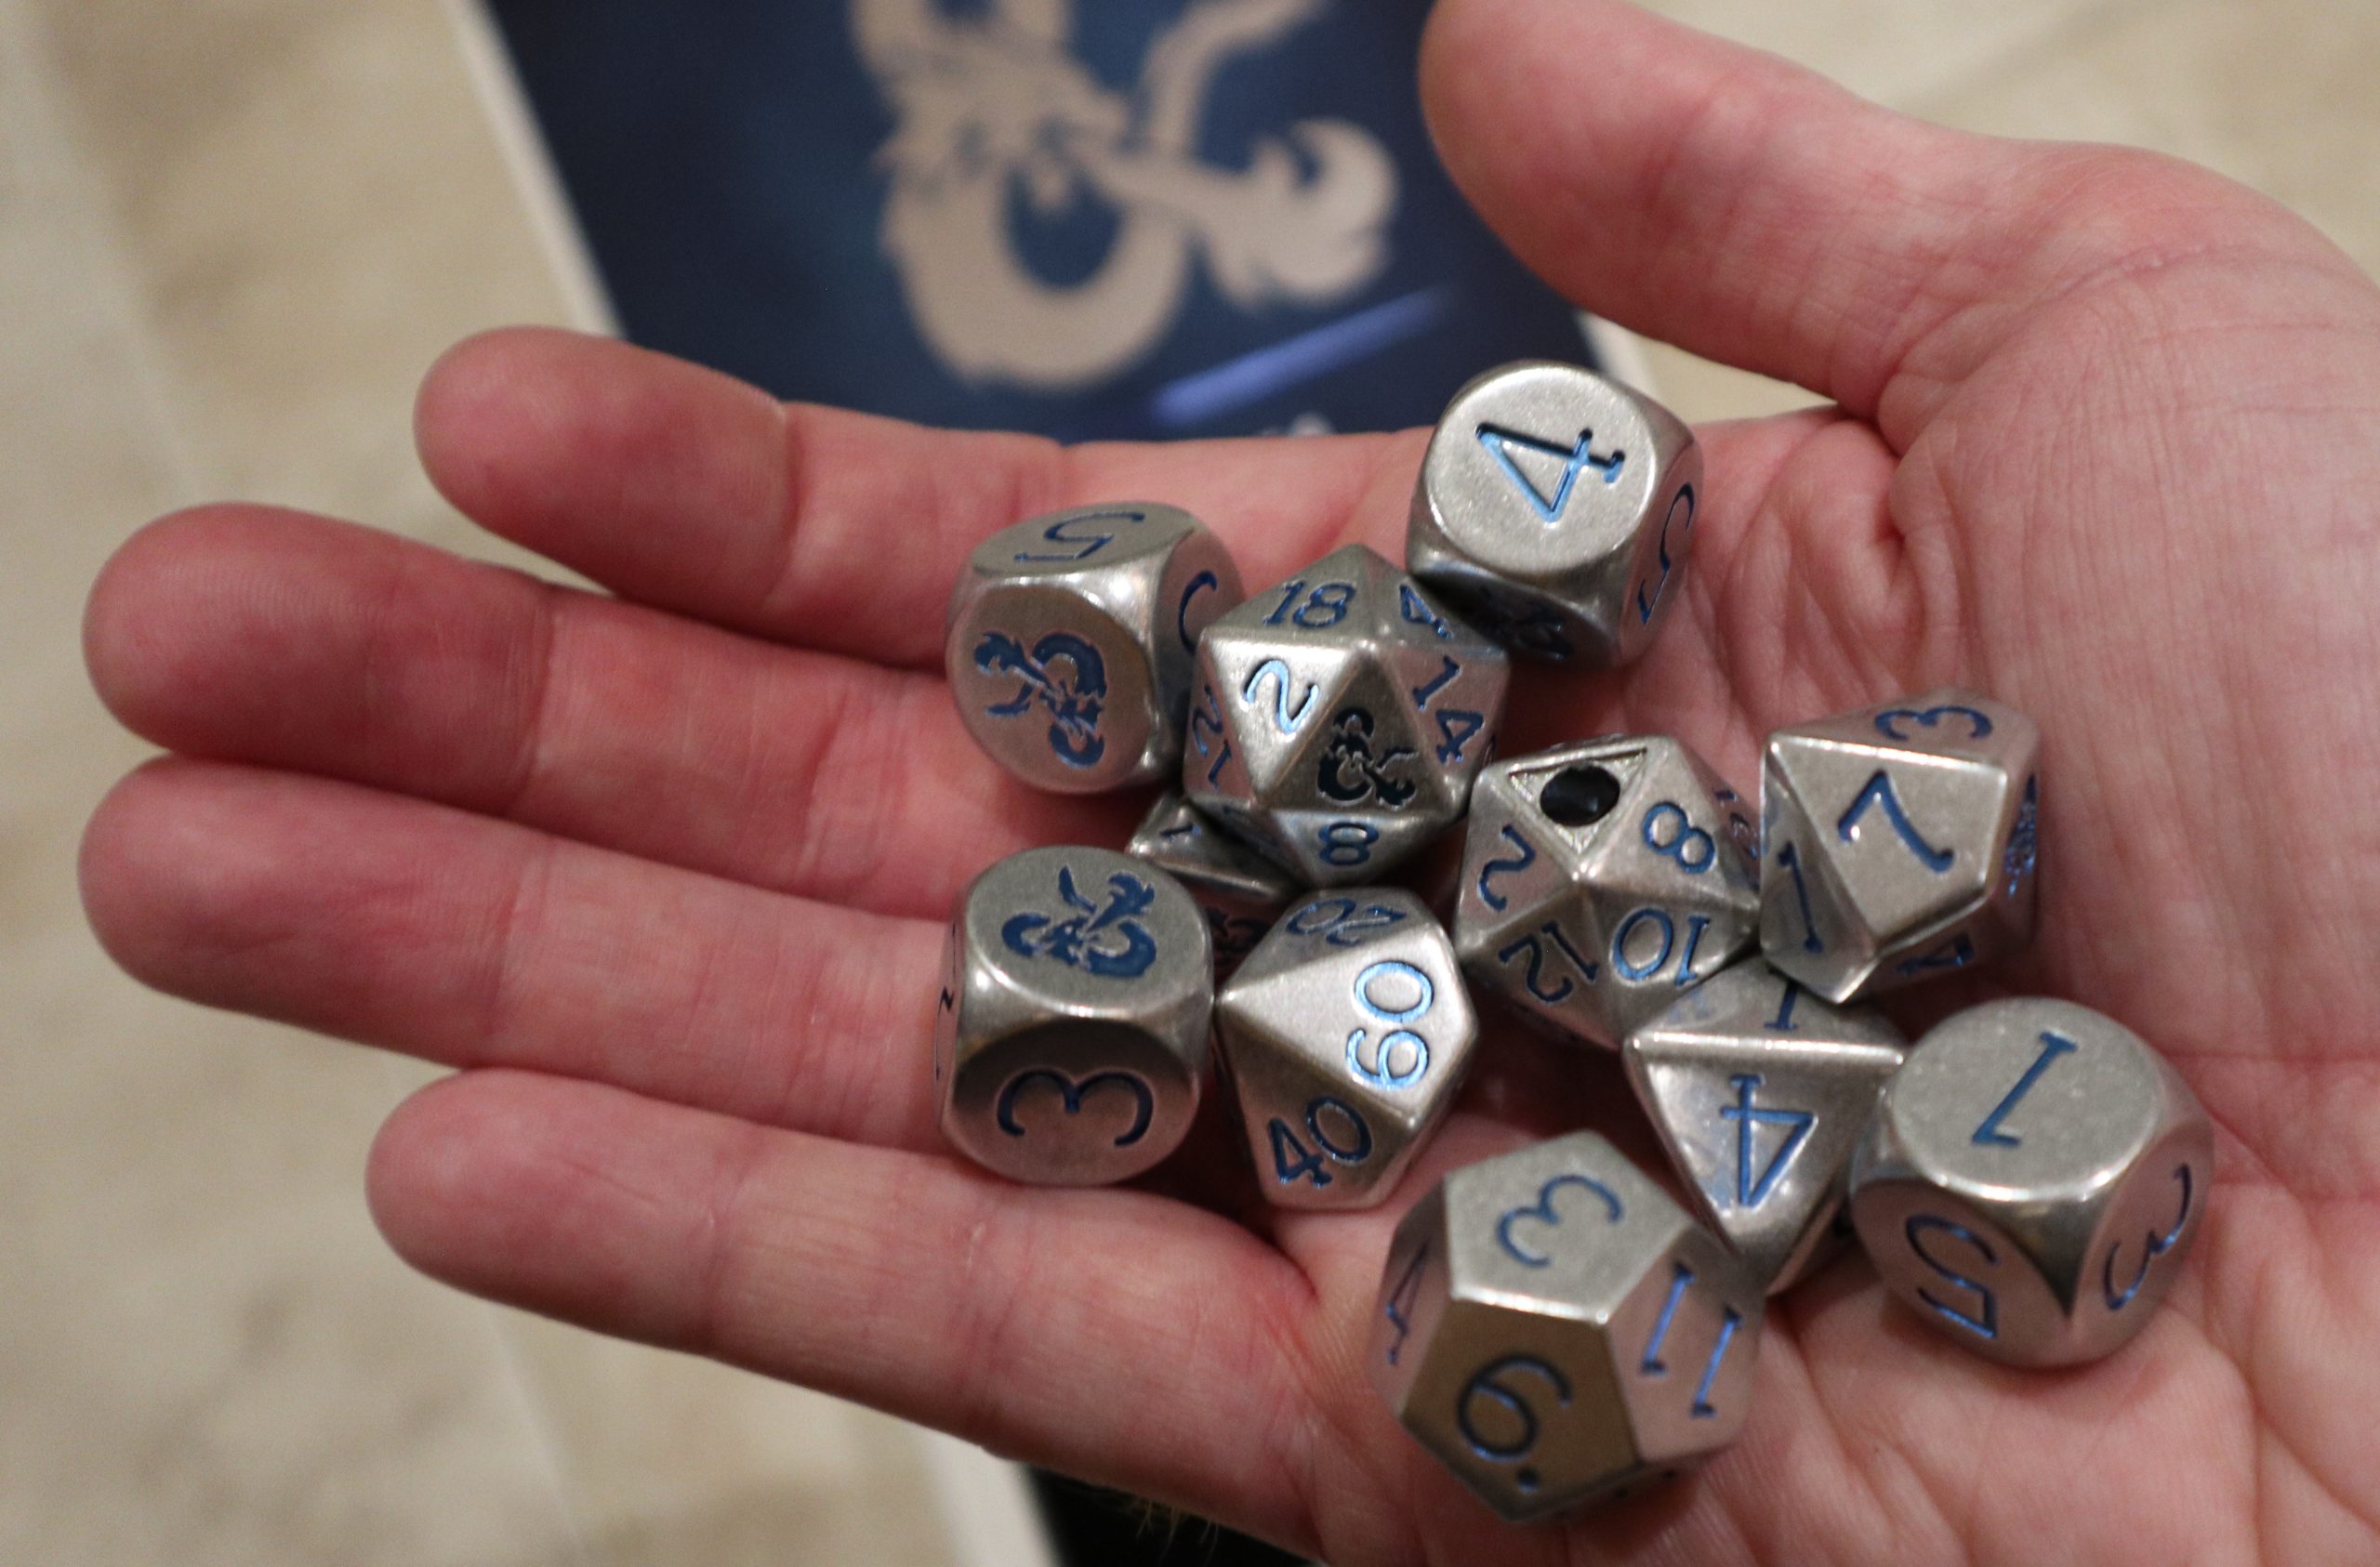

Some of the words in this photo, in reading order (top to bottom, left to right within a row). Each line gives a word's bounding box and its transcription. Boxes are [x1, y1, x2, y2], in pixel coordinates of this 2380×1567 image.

[1475, 422, 1625, 522] 4
[1013, 512, 1145, 561] 5
[1262, 579, 1356, 630] 18
[1398, 584, 1454, 641] 4
[1241, 658, 1320, 736] 2
[1874, 705, 1993, 741] 3
[1316, 822, 1380, 866] 8
[1640, 801, 1718, 876] 8
[1837, 770, 1956, 875] 7
[1778, 841, 1824, 955] 1
[1497, 920, 1601, 1005] 12
[1610, 906, 1712, 987] 10
[1346, 959, 1435, 1091] 60
[997, 1071, 1154, 1148] 3
[1971, 1030, 2079, 1149] 1
[1267, 1095, 1373, 1189] 40
[1720, 1073, 1819, 1210] 4
[1495, 1174, 1624, 1269] 3
[2103, 1162, 2192, 1310] 3
[1905, 1214, 2001, 1338] 5
[1639, 1261, 1744, 1419] 11
